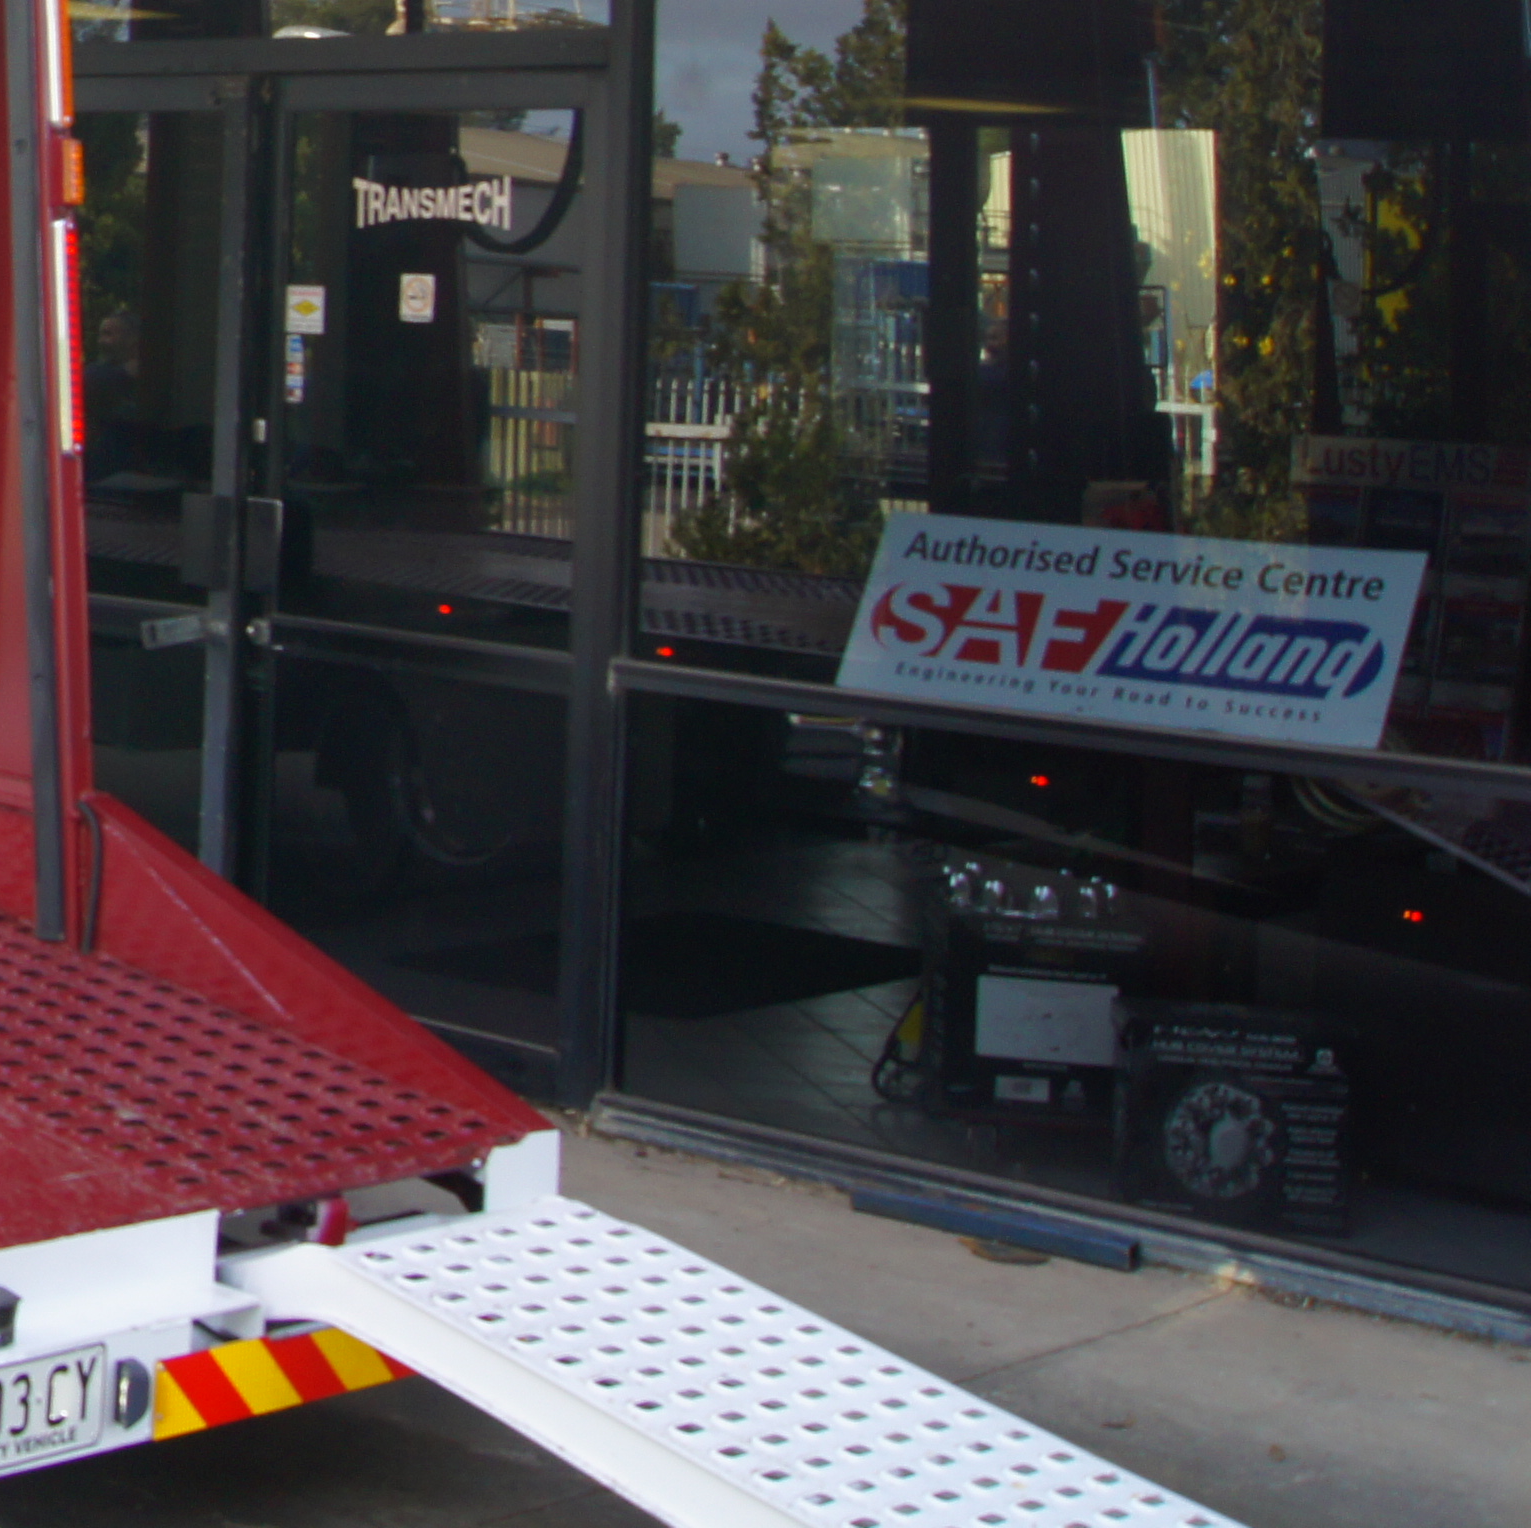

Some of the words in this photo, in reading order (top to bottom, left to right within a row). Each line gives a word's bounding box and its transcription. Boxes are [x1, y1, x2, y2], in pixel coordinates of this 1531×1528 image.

[352, 175, 512, 230] TRANSMECH
[904, 529, 1099, 577] Authorised
[1109, 548, 1243, 591] Service
[1257, 562, 1386, 602] Centre
[871, 580, 1127, 675] SAF
[894, 660, 1035, 694] Engineering
[1049, 678, 1099, 698] Your
[1112, 685, 1171, 707] Road
[1184, 693, 1209, 712] to
[1224, 698, 1323, 723] Success
[15, 1425, 77, 1454] VEHICLE
